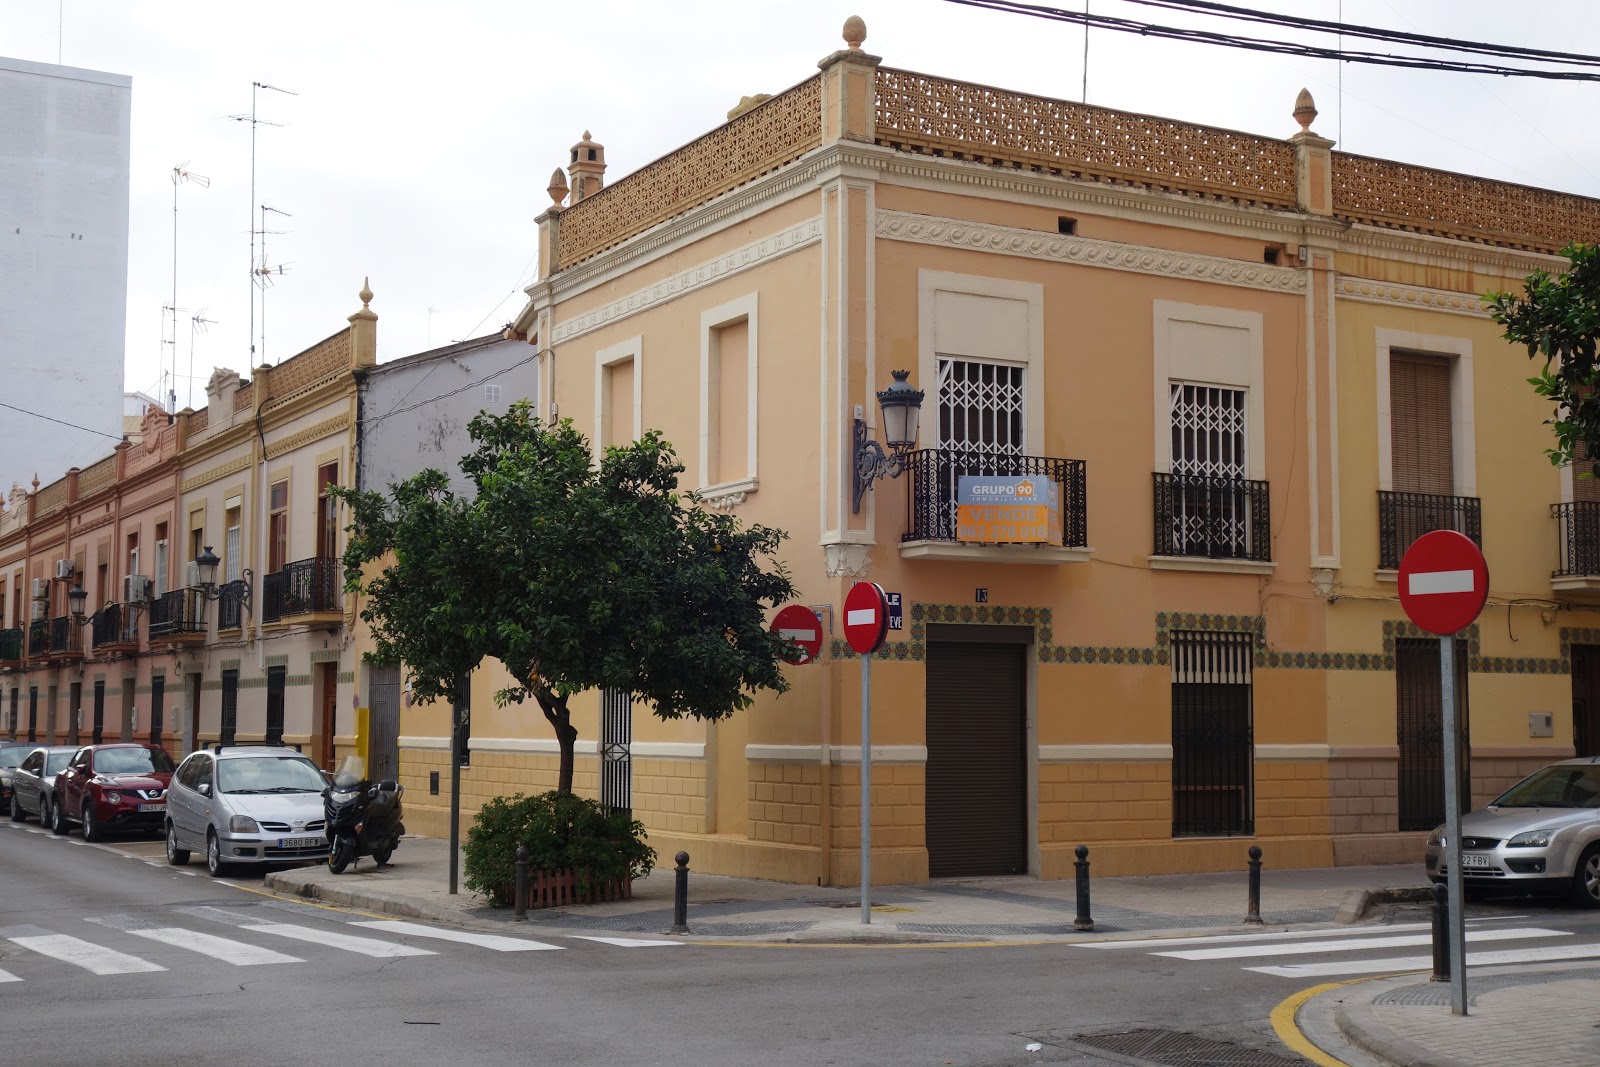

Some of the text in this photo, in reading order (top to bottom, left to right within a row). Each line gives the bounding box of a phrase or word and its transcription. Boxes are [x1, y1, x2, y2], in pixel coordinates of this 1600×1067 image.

[972, 485, 1032, 495] GRUPO 90
[970, 507, 1038, 522] VENDE
[959, 525, 986, 539] 963
[1020, 525, 1047, 539] 016
[977, 589, 987, 602] 13
[283, 839, 303, 847] 3680
